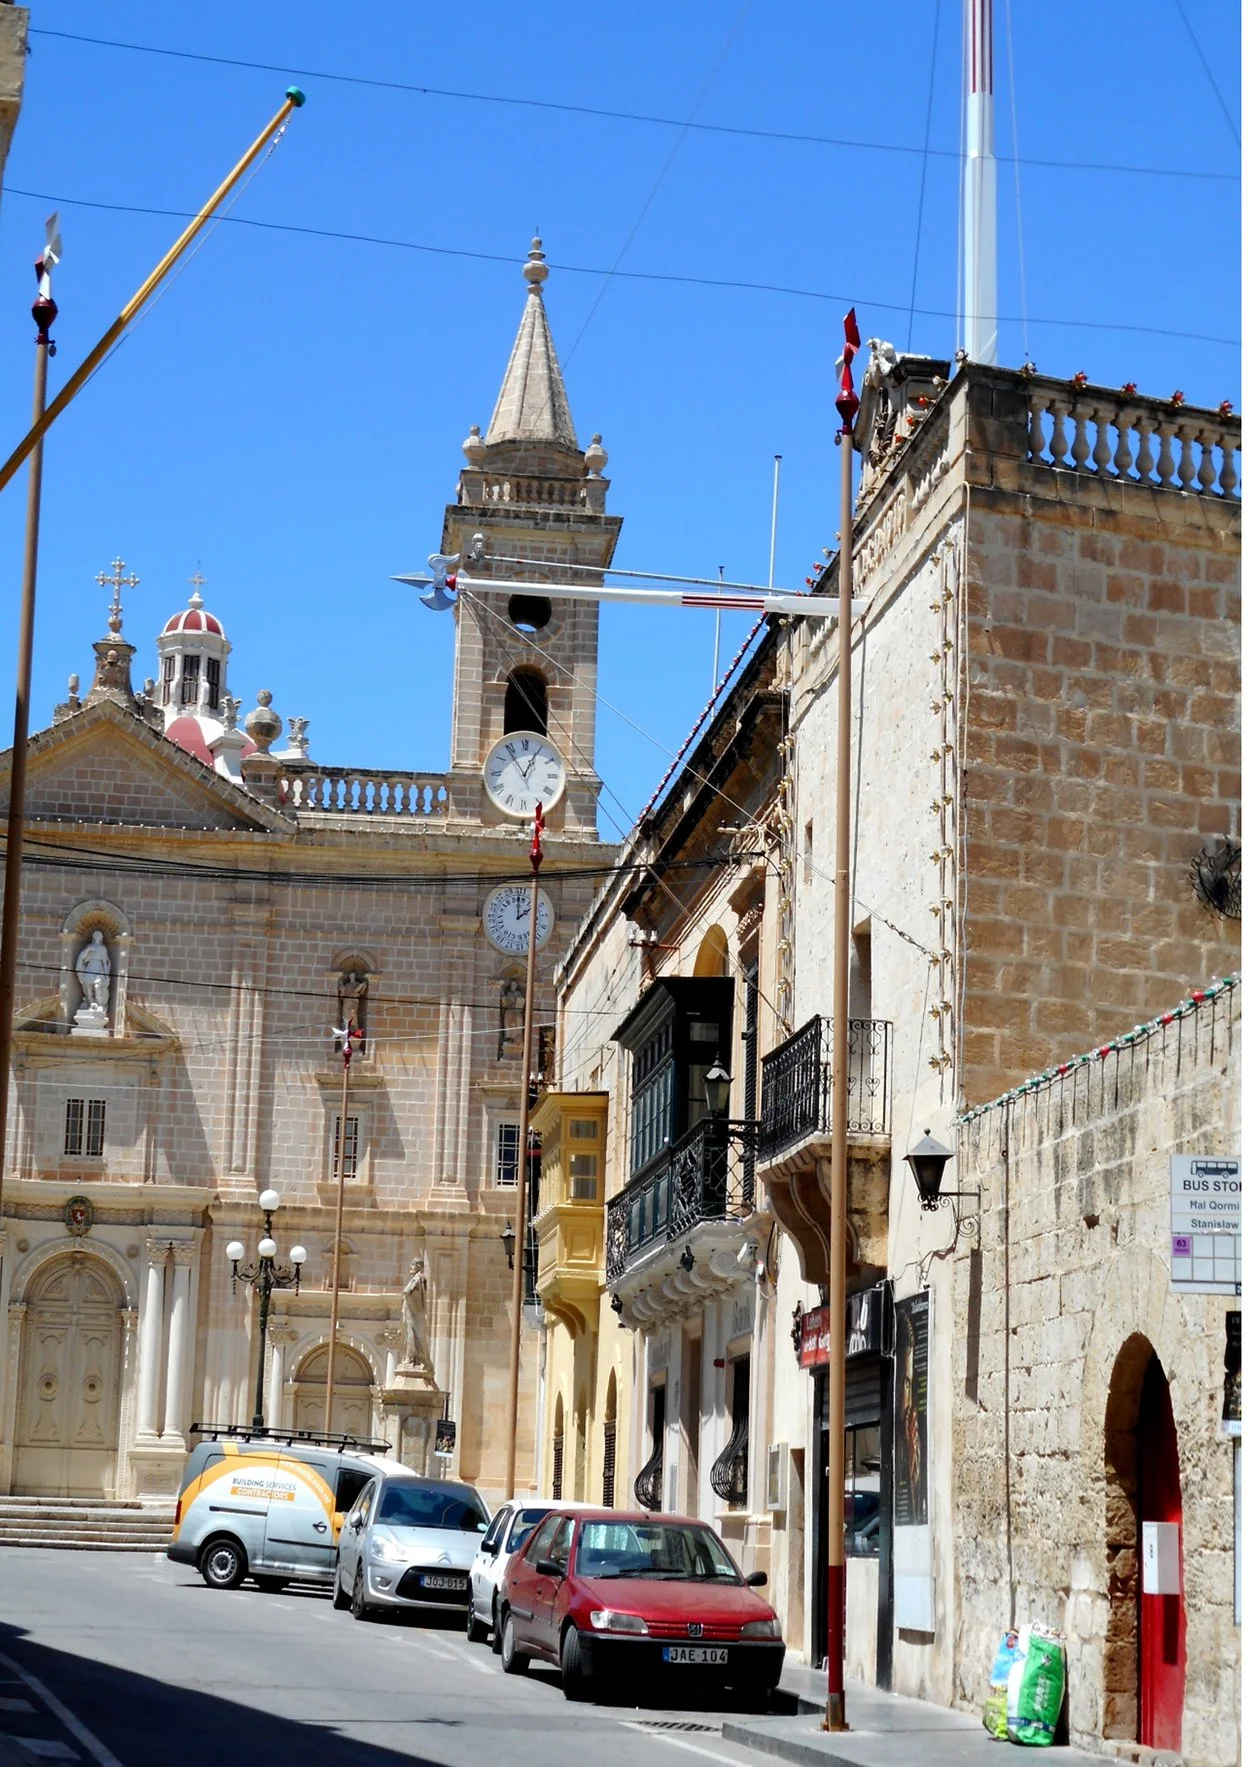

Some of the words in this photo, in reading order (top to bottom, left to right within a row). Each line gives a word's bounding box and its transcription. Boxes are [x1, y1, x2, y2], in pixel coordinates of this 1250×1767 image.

[1183, 1180, 1210, 1192] BUS
[1209, 1201, 1240, 1211] Qormi
[1191, 1218, 1239, 1229] Stanislaw
[232, 1477, 264, 1487] BUILDING
[265, 1481, 297, 1491] SERVICES
[237, 1487, 289, 1500] CONTRACTORS
[670, 1648, 696, 1662] JAE
[702, 1649, 728, 1662] 104
